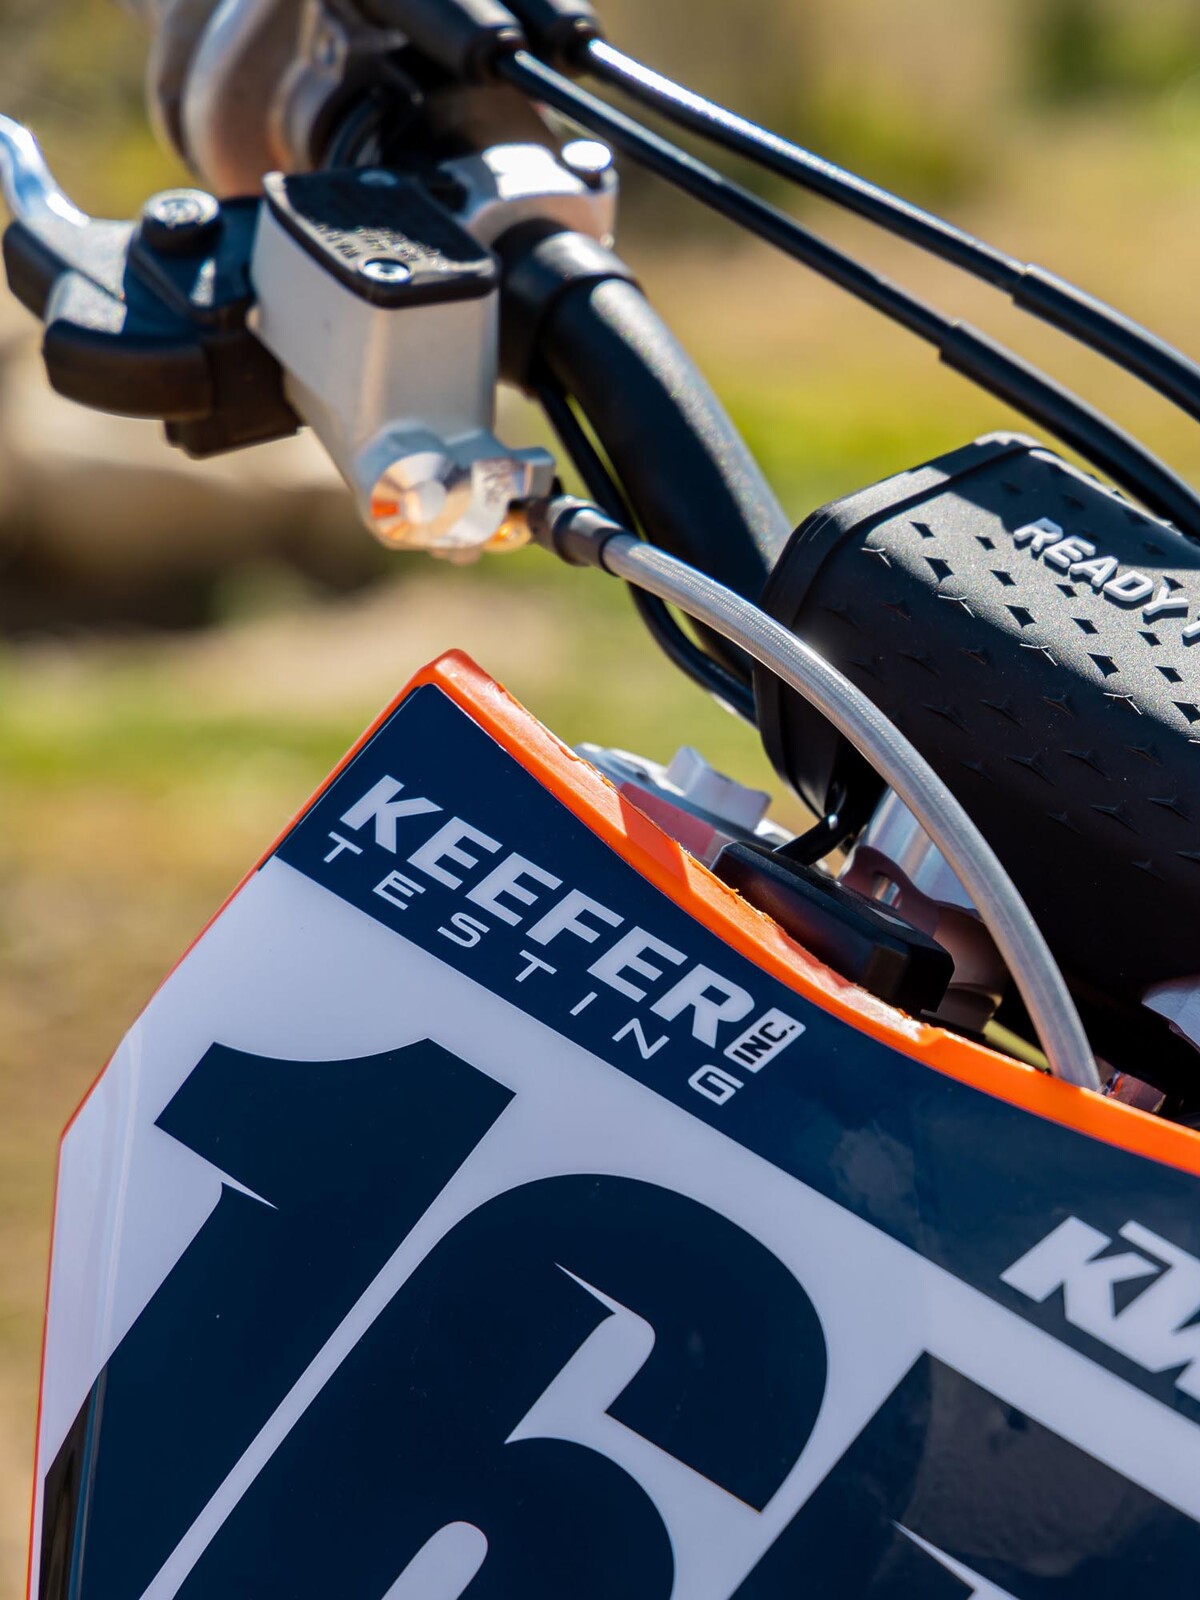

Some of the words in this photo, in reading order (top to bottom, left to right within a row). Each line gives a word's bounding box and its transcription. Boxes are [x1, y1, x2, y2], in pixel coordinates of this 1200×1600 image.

[1013, 518, 1189, 617] READY
[323, 831, 744, 1105] TESTING
[340, 774, 755, 1048] KEEFER
[730, 1018, 799, 1067] INC.
